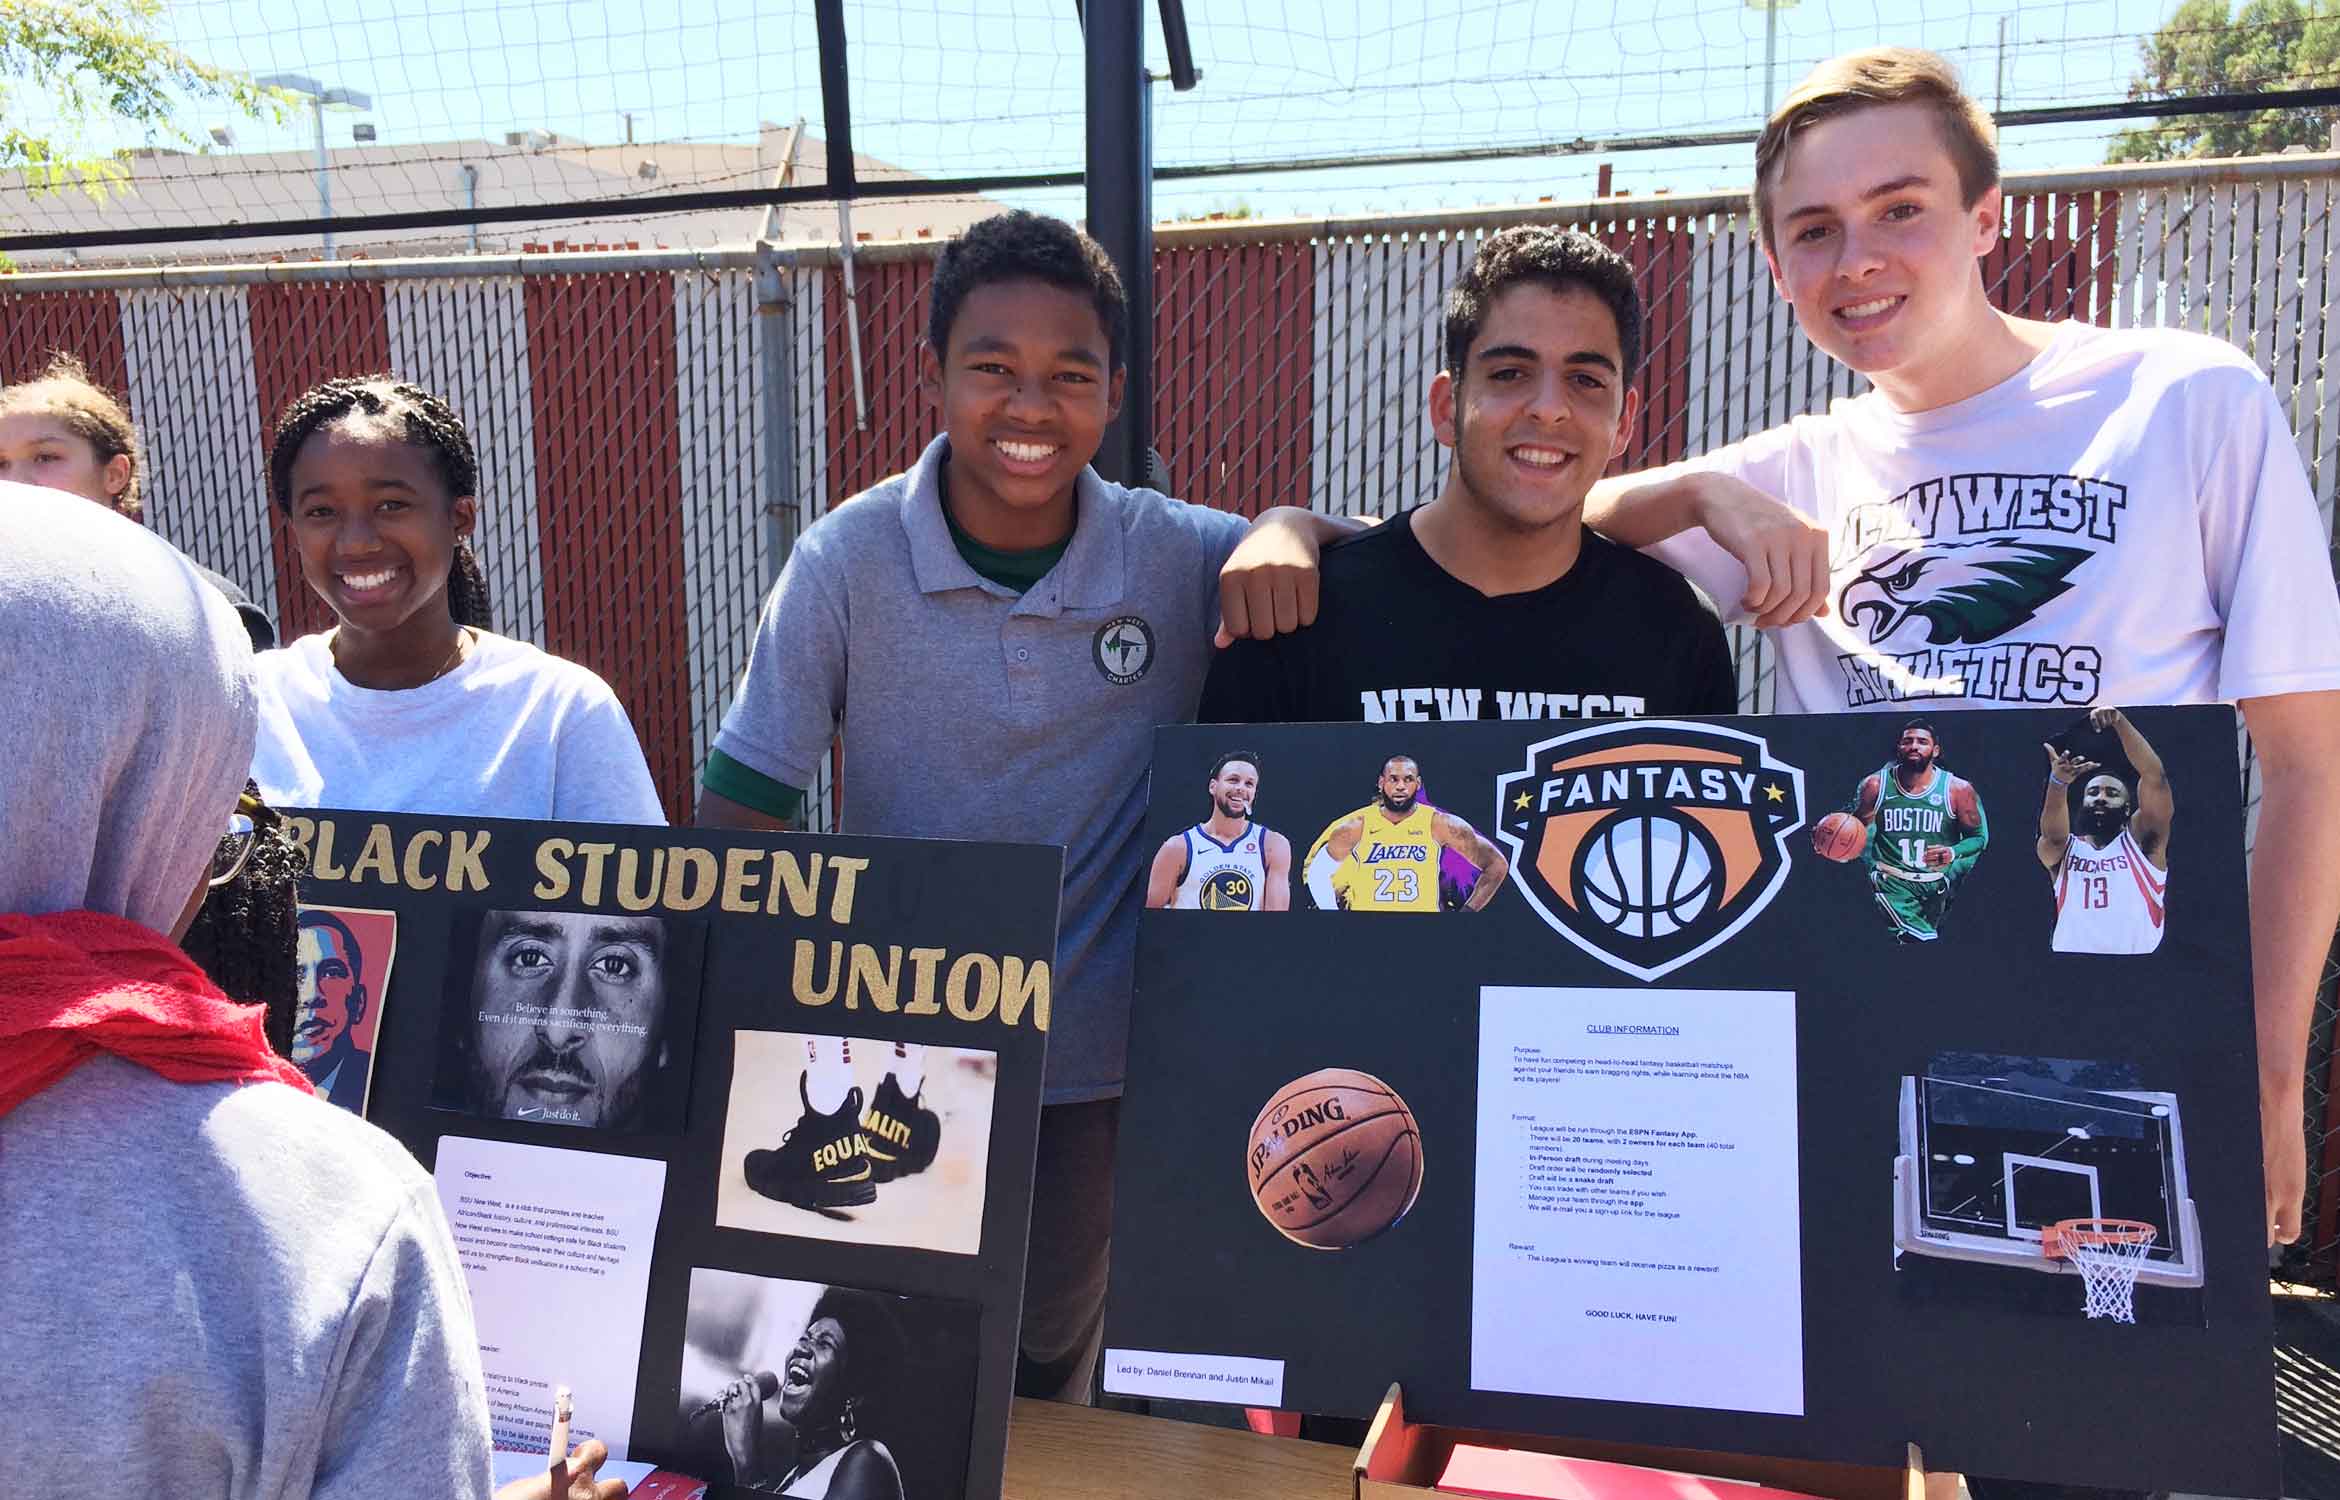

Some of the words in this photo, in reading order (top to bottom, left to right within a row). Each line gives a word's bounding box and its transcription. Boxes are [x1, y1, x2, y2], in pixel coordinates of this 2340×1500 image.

[1950, 473, 2127, 543] WEST
[1837, 642, 2102, 707] ATHLETICS
[1539, 767, 1756, 813] FANTASY
[1883, 808, 1944, 833] BOSTON
[1363, 842, 1427, 864] LAKERS
[1897, 838, 1927, 868] 11
[285, 816, 492, 892] BLACK
[533, 837, 870, 925] STUDENT
[2068, 853, 2128, 874] ROCKETS
[1200, 864, 1231, 884] GOLDEN
[1233, 863, 1256, 880] STATE
[1226, 879, 1247, 896] 30
[1374, 868, 1420, 902] 23
[2083, 877, 2109, 909] 13
[791, 939, 1053, 1032] UNION
[516, 1002, 547, 1015] Believe
[550, 1005, 558, 1015] in
[478, 1011, 500, 1024] Even
[501, 1012, 510, 1025] if
[511, 1013, 517, 1024] it
[518, 1015, 548, 1026] means
[550, 1016, 595, 1032] sacrificing
[1586, 1024, 1612, 1033] CLUB
[1614, 1025, 1680, 1035] INFORMATION
[1538, 1067, 1552, 1075] your
[1554, 1066, 1575, 1074] friends
[1601, 1068, 1630, 1077] bragging
[1654, 1069, 1670, 1077] while
[1672, 1070, 1698, 1079] learning
[1553, 1057, 1585, 1067] competing
[1640, 1059, 1664, 1069] fantasy
[1665, 1060, 1699, 1068] basketball
[1701, 1061, 1733, 1071] matchups
[542, 1107, 559, 1120] Just
[560, 1108, 572, 1120] do
[572, 1110, 581, 1121] it.
[1251, 1096, 1345, 1180] SPDING
[1530, 1124, 1554, 1134] League
[1590, 1126, 1615, 1136] through
[1651, 1129, 1679, 1139] Fantasy
[1687, 1140, 1705, 1148] team
[1529, 1163, 1545, 1171] Draft
[1587, 1167, 1620, 1176] randomly
[1623, 1168, 1652, 1176] selected
[1583, 1156, 1602, 1165] during
[1528, 1173, 1545, 1181] Draft
[1529, 1183, 1542, 1191] You
[1609, 1187, 1629, 1195] teams
[1529, 1193, 1554, 1203] Manage
[1557, 1196, 1570, 1204] your
[1590, 1196, 1616, 1206] through
[1542, 1254, 1572, 1264] League's
[1573, 1257, 1599, 1267] winning
[1658, 1262, 1675, 1271] pizza
[1585, 1310, 1609, 1318] GOOD
[1610, 1311, 1634, 1320] LUCK,
[1635, 1312, 1657, 1321] HAVE
[1658, 1314, 1677, 1322] FUN!
[1116, 1363, 1131, 1374] Led
[1147, 1366, 1172, 1378] Daniel
[1173, 1369, 1207, 1381] Brennan
[1208, 1370, 1223, 1382] and
[1225, 1371, 1248, 1384] Justin
